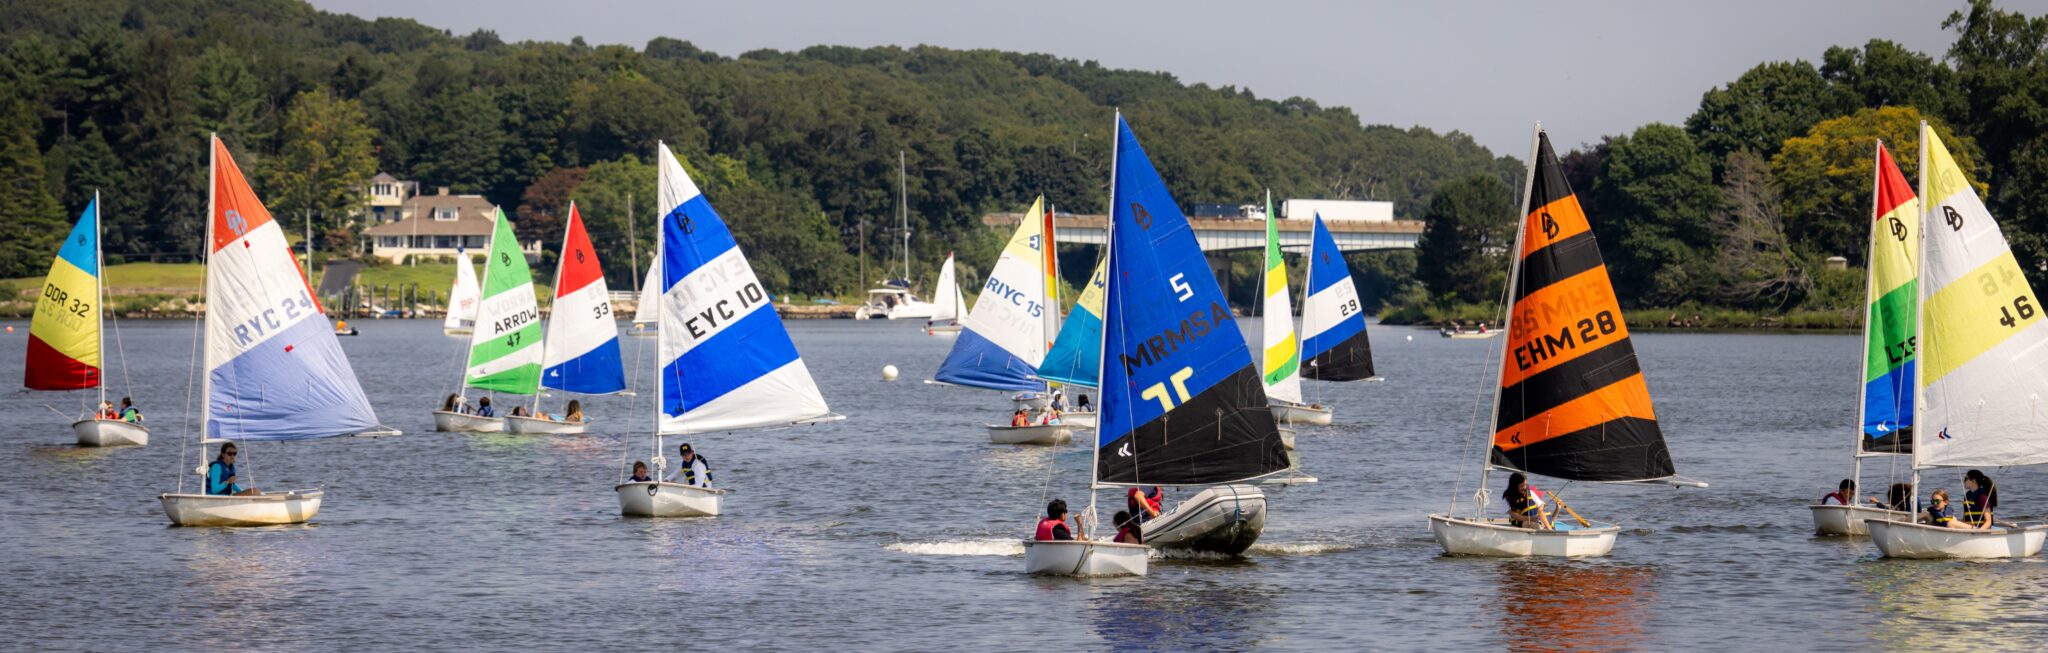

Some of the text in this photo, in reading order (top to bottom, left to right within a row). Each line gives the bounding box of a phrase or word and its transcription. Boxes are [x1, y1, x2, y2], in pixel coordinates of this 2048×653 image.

[45, 283, 90, 318] DDR 32
[986, 276, 1044, 318] RIYC 15
[1169, 272, 1194, 303] 5
[234, 289, 313, 346] RYC 24
[494, 306, 537, 335] ARROW
[593, 302, 609, 319] 33
[685, 282, 763, 340] EYC 10
[1340, 299, 1357, 317] 29
[2000, 295, 2035, 328] 46
[506, 332, 521, 347] 47
[1119, 300, 1233, 377] MRMSA
[1514, 310, 1617, 372] EHM 28
